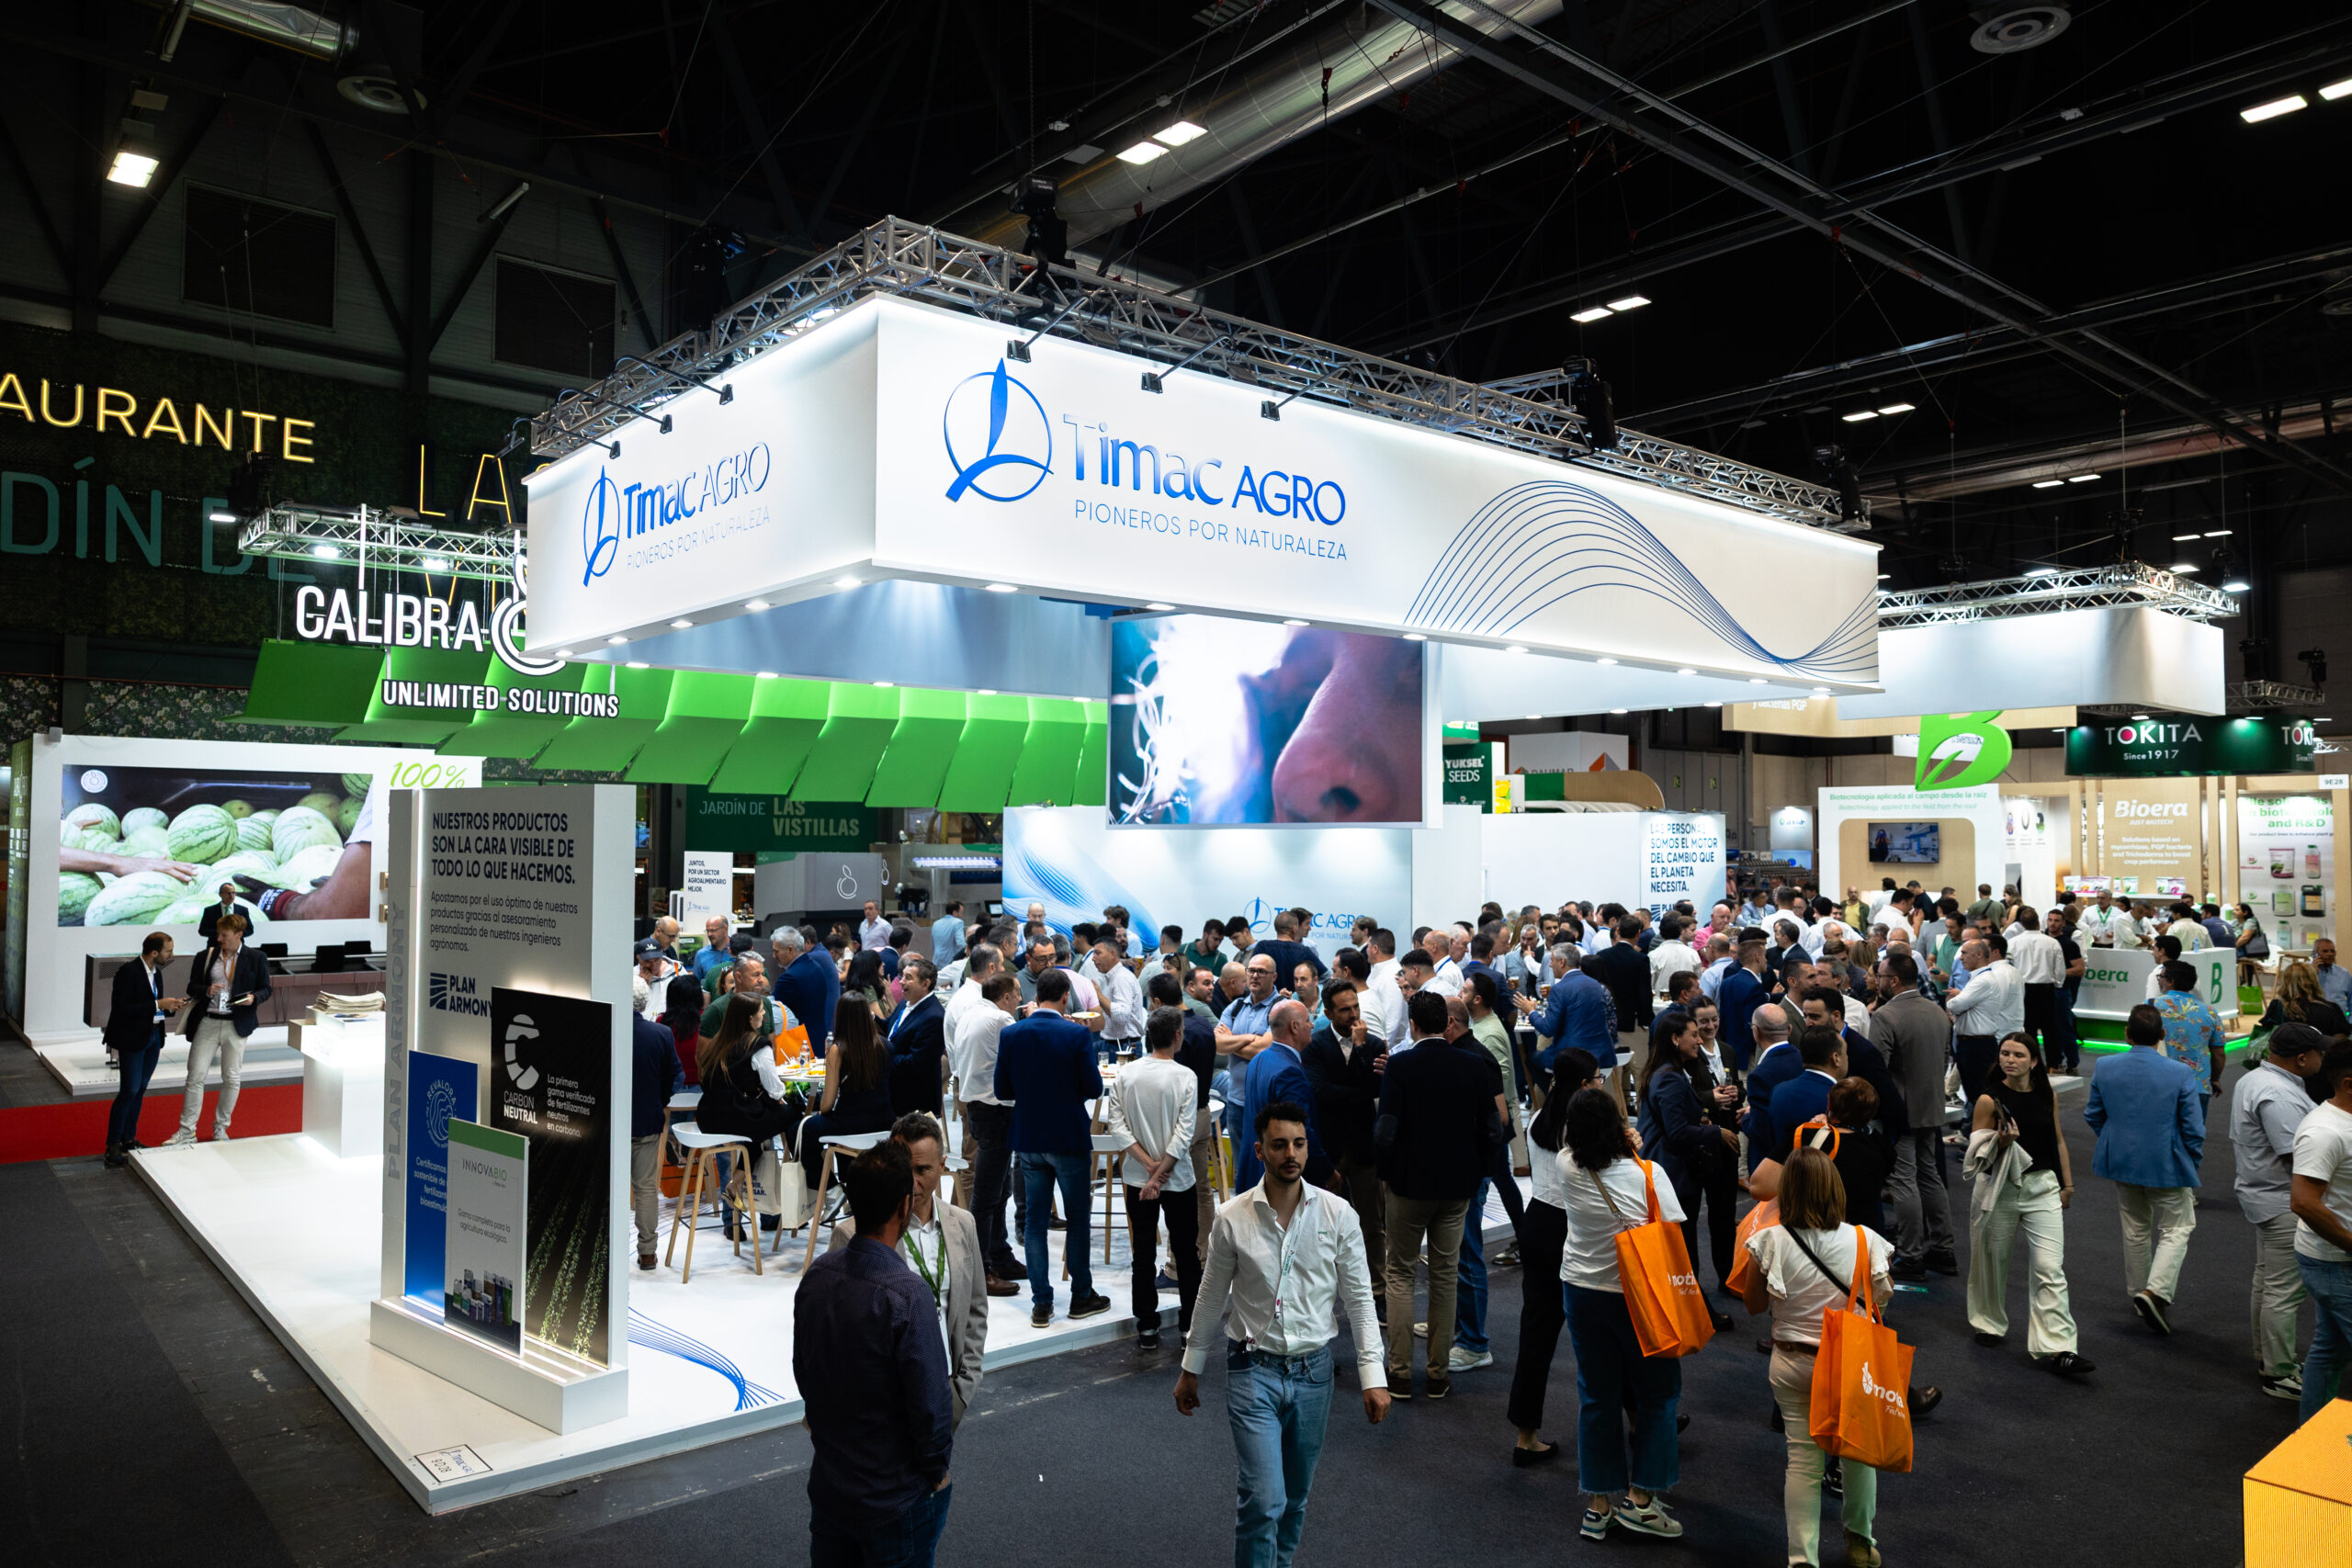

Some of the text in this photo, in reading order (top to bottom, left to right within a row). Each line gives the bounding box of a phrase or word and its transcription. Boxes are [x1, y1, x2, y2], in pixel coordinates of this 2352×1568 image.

[699, 442, 770, 512] AGRO
[1232, 465, 1346, 525] AGRO
[627, 506, 770, 570] PIONEROS POR NATURALEZA
[1075, 500, 1348, 560] PIONEROS POR NATURALEZA
[296, 585, 483, 652] CALIBRA
[383, 681, 619, 717] UNLIMITED SOLUTIONS
[2105, 723, 2202, 745] TOKITA
[390, 761, 468, 788] 100%
[1449, 771, 1480, 783] SEEDS
[699, 797, 805, 816] JARDÍN DE LAS
[2115, 799, 2188, 818] Bioera
[433, 812, 568, 831] NUESTROS PRODUCTOS
[773, 818, 859, 836] VISTILLAS
[2268, 818, 2291, 828] and
[432, 836, 574, 858] SON LA CARA VISIBLE DE
[1651, 837, 1718, 849] SOMOS EL MOTOR
[1651, 852, 1714, 863] DEL CAMBIO QUE
[432, 859, 575, 885] TODO LO QUE HACEMOS.
[1651, 866, 1694, 878] EL PLANETA
[1651, 881, 1689, 893] NECESITA.
[431, 891, 578, 915] Apostamos por el uso óptimo de nuestros
[431, 906, 556, 929] productos gracias al asesoramiento
[431, 922, 560, 946] personalizado de nuestros ingenieros
[430, 937, 469, 952] agrónomos.
[450, 975, 476, 995] PLAN
[388, 900, 405, 1180] PLAN ARMONY
[548, 1073, 578, 1089] La primera
[426, 1079, 457, 1106] REVALORA
[504, 1090, 534, 1109] CARBON
[548, 1088, 595, 1104] gama verificada
[503, 1104, 538, 1125] NEUTRAL
[548, 1098, 590, 1115] de fertilizantes
[548, 1110, 569, 1122] neutros
[555, 1124, 581, 1138] carbono.
[462, 1158, 507, 1181] INNOVABIO
